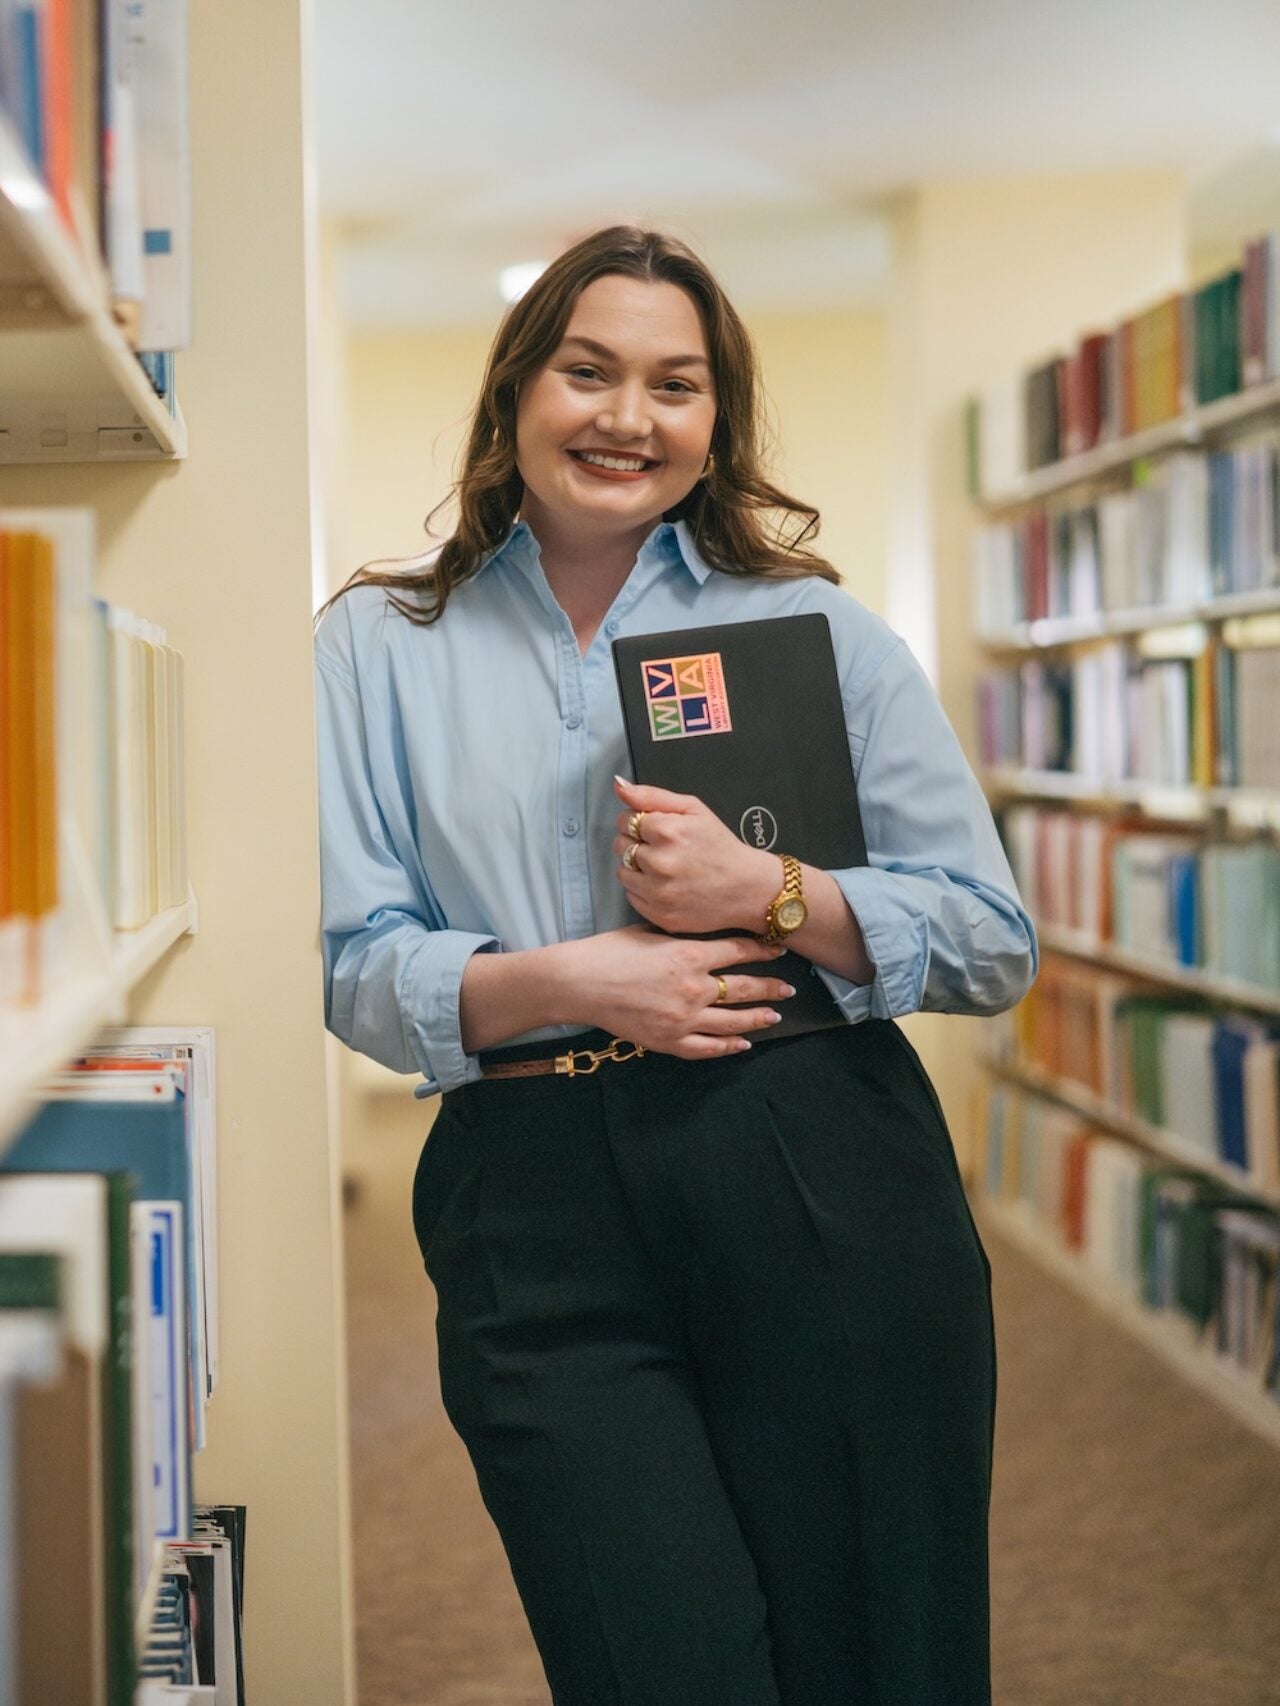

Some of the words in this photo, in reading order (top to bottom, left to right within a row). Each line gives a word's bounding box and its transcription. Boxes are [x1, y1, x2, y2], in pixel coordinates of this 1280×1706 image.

[705, 658, 717, 699] VIRGINIA
[711, 703, 722, 729] WEST
[752, 810, 766, 846] DELL
